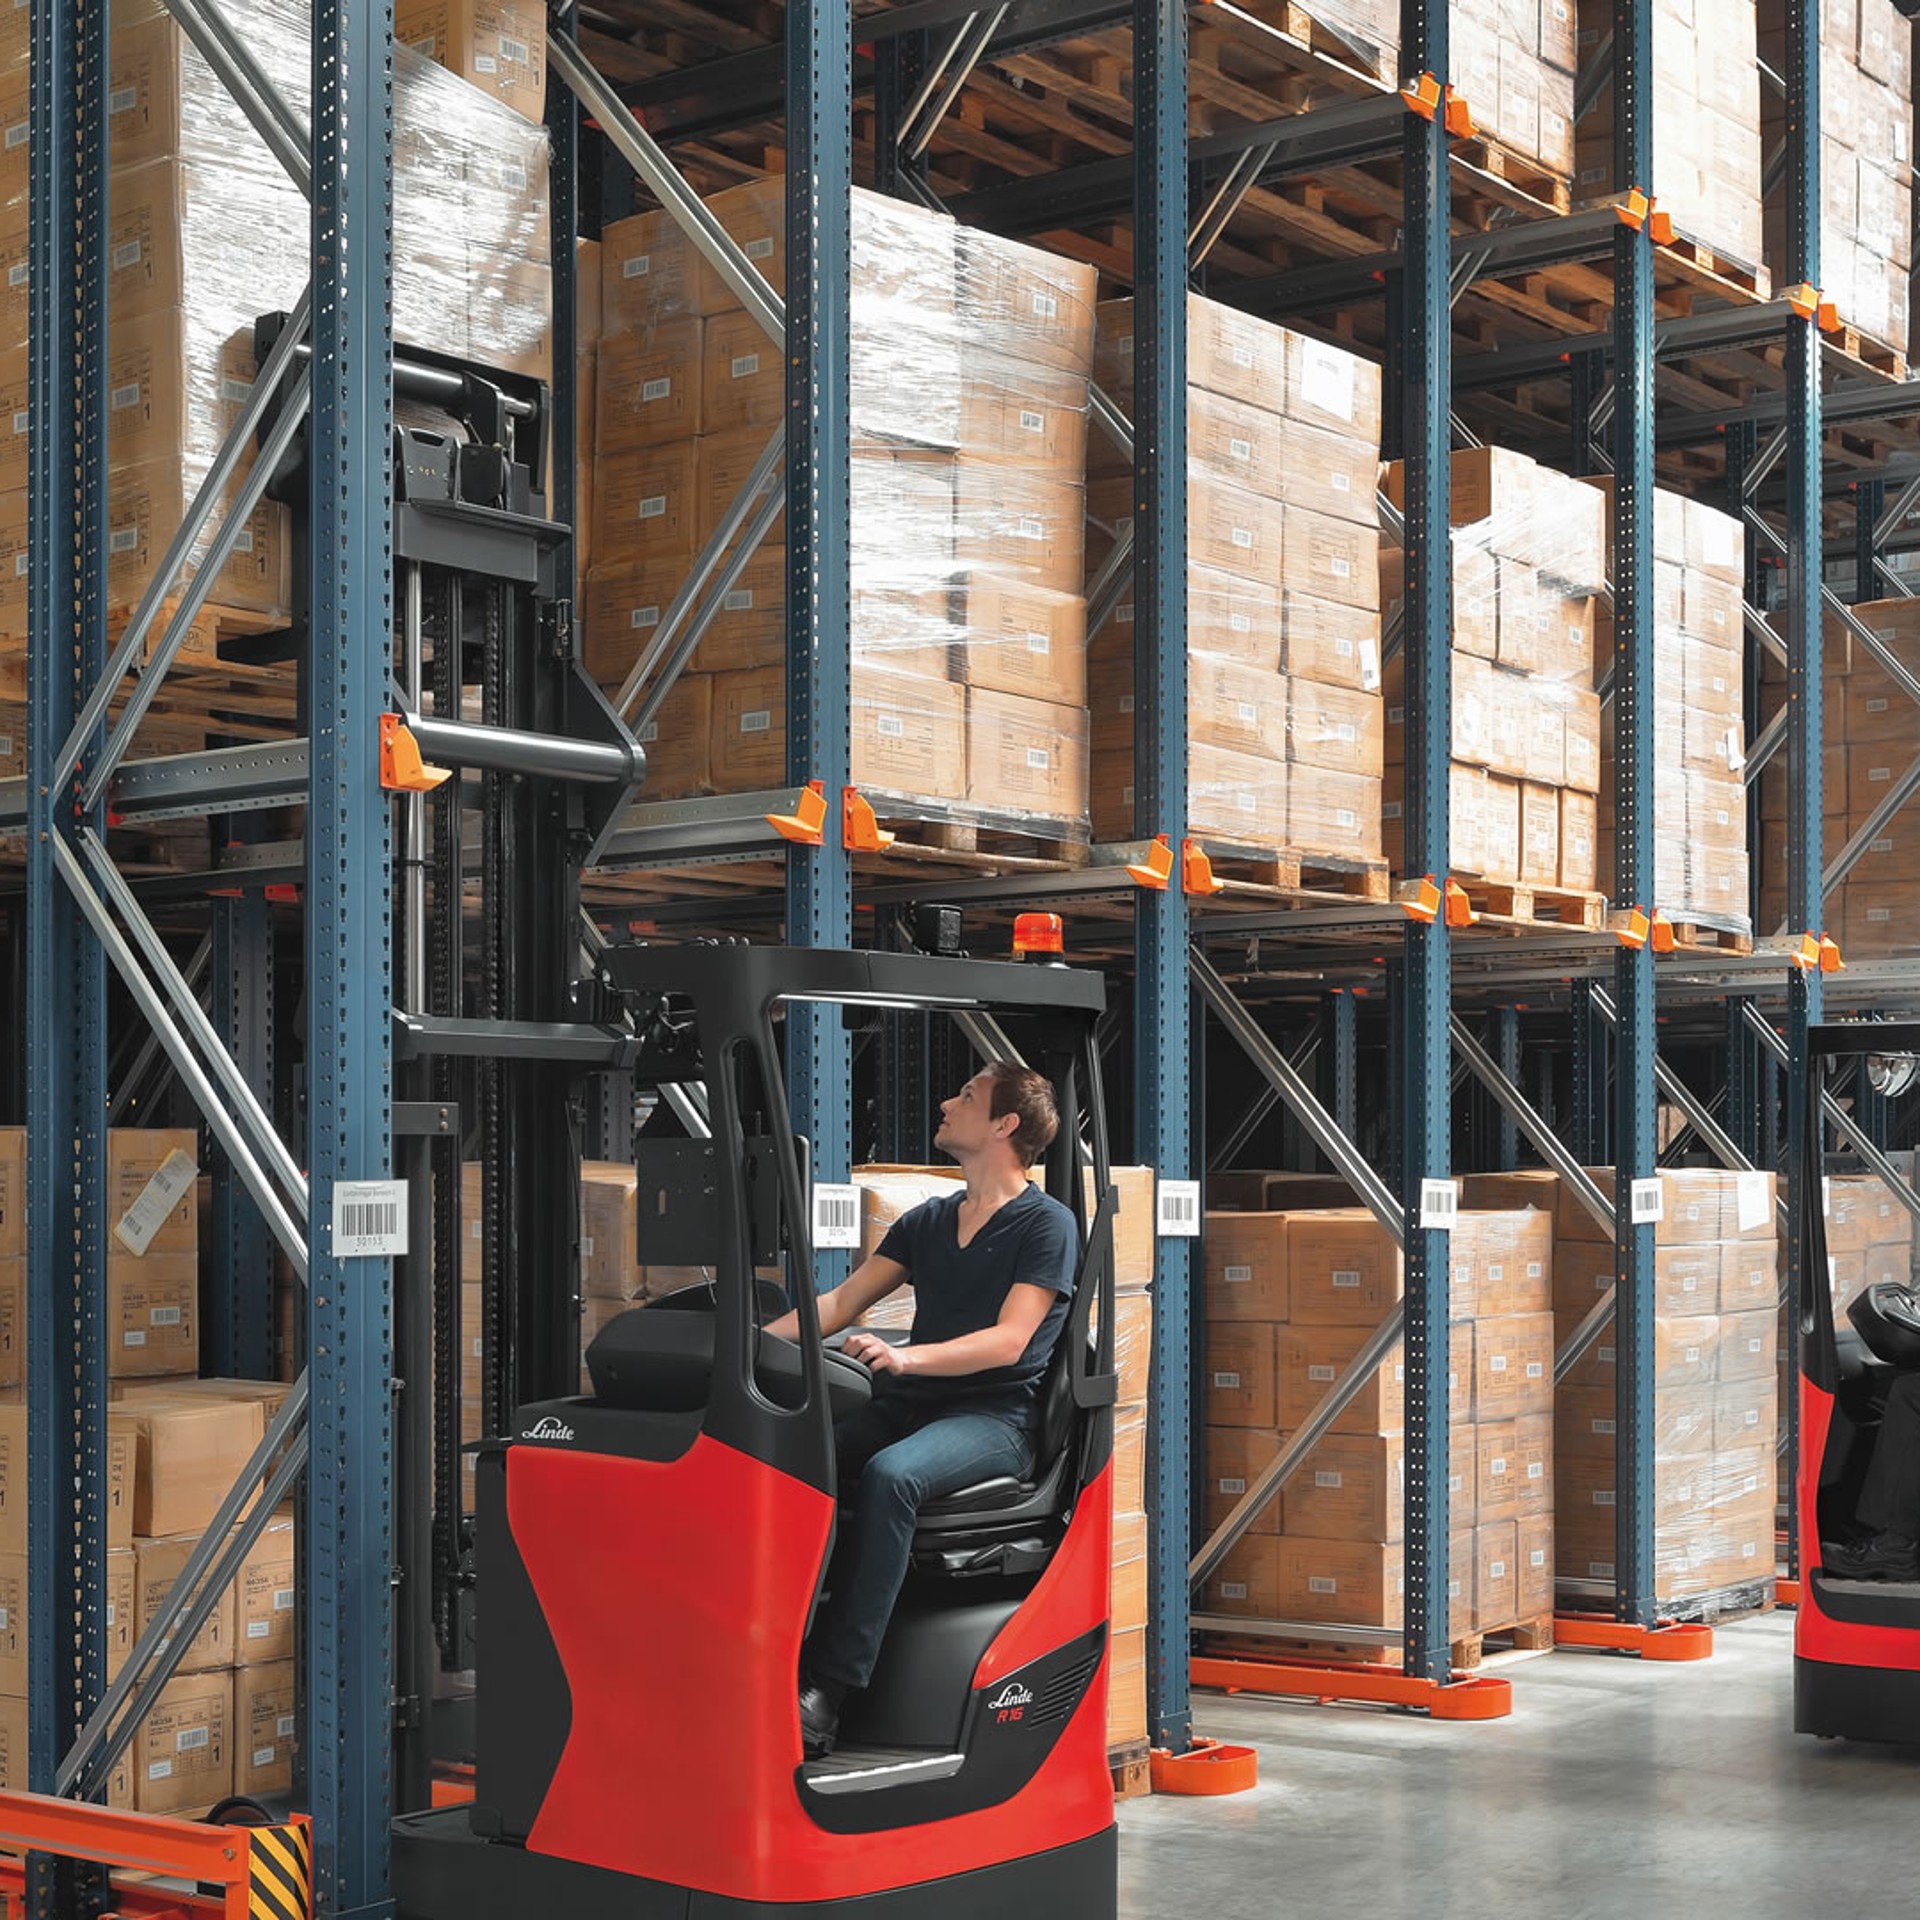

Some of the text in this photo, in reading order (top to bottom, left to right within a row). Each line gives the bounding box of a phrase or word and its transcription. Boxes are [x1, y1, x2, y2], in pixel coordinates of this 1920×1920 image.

[533, 70, 540, 86] 1
[258, 556, 265, 573] 1
[181, 1206, 188, 1220] 1
[181, 1323, 190, 1339] 1
[4, 1334, 10, 1350] 1
[521, 1416, 575, 1441] Linde
[112, 1489, 120, 1507] 1
[10, 1632, 15, 1651] 1
[119, 1626, 127, 1643] 1
[211, 1625, 218, 1643] 1
[988, 1683, 1033, 1709] Linde
[213, 1744, 220, 1762] 1
[117, 1774, 124, 1792] 1
